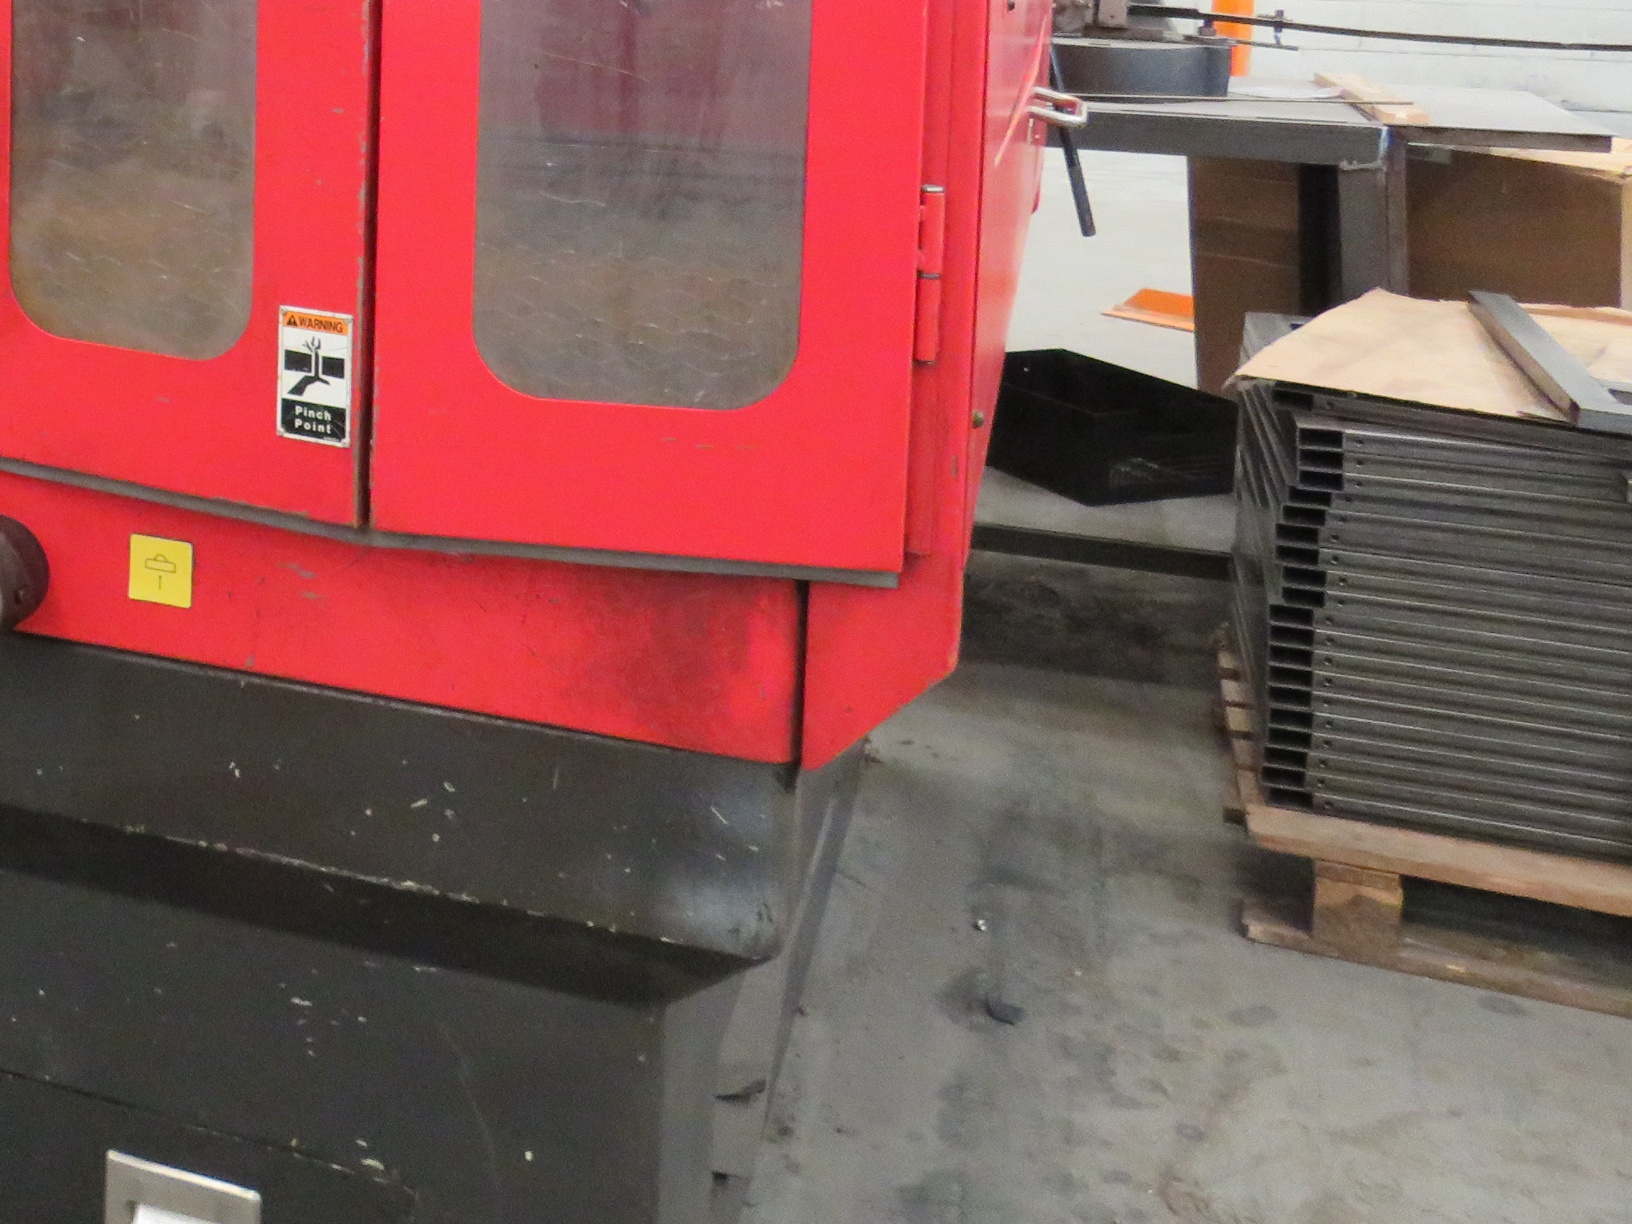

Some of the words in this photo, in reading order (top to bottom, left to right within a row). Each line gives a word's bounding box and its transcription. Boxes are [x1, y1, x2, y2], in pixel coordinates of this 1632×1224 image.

[298, 315, 344, 334] WARNING
[295, 405, 331, 421] Pinch
[295, 418, 331, 434] Point
